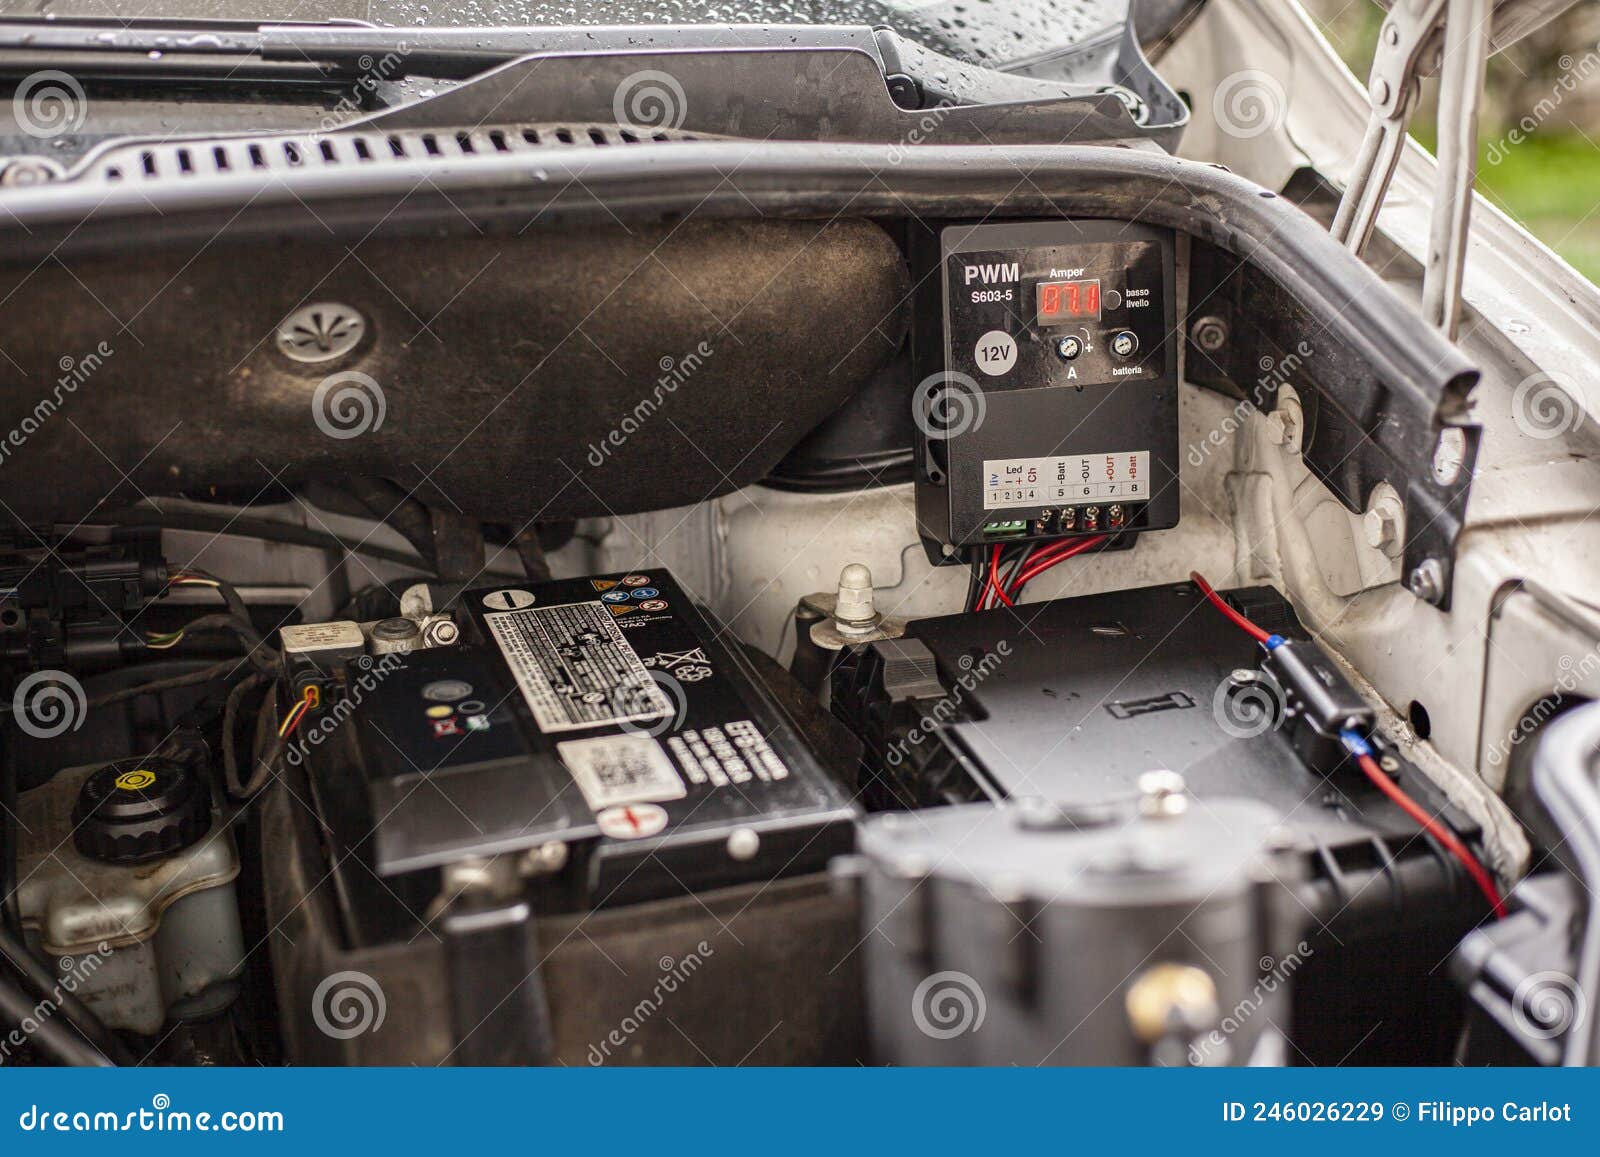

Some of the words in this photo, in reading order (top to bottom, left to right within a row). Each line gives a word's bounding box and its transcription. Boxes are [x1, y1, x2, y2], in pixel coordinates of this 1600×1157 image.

[964, 263, 1019, 285] PWM
[1050, 268, 1084, 279] Amper
[971, 290, 1013, 303] S603-5
[1126, 288, 1149, 297] basso
[1126, 299, 1149, 308] livello
[981, 345, 1010, 362] 12V
[1067, 366, 1078, 380] A
[1112, 366, 1142, 376] batteria
[1006, 466, 1022, 474] Led
[1027, 467, 1037, 483] Ch
[993, 492, 997, 500] 1
[1005, 492, 1011, 500] 2
[1017, 491, 1022, 499] 3
[1029, 490, 1034, 498] 4
[1083, 487, 1090, 495] 6
[1109, 485, 1115, 493] 7
[1131, 484, 1138, 492] 8
